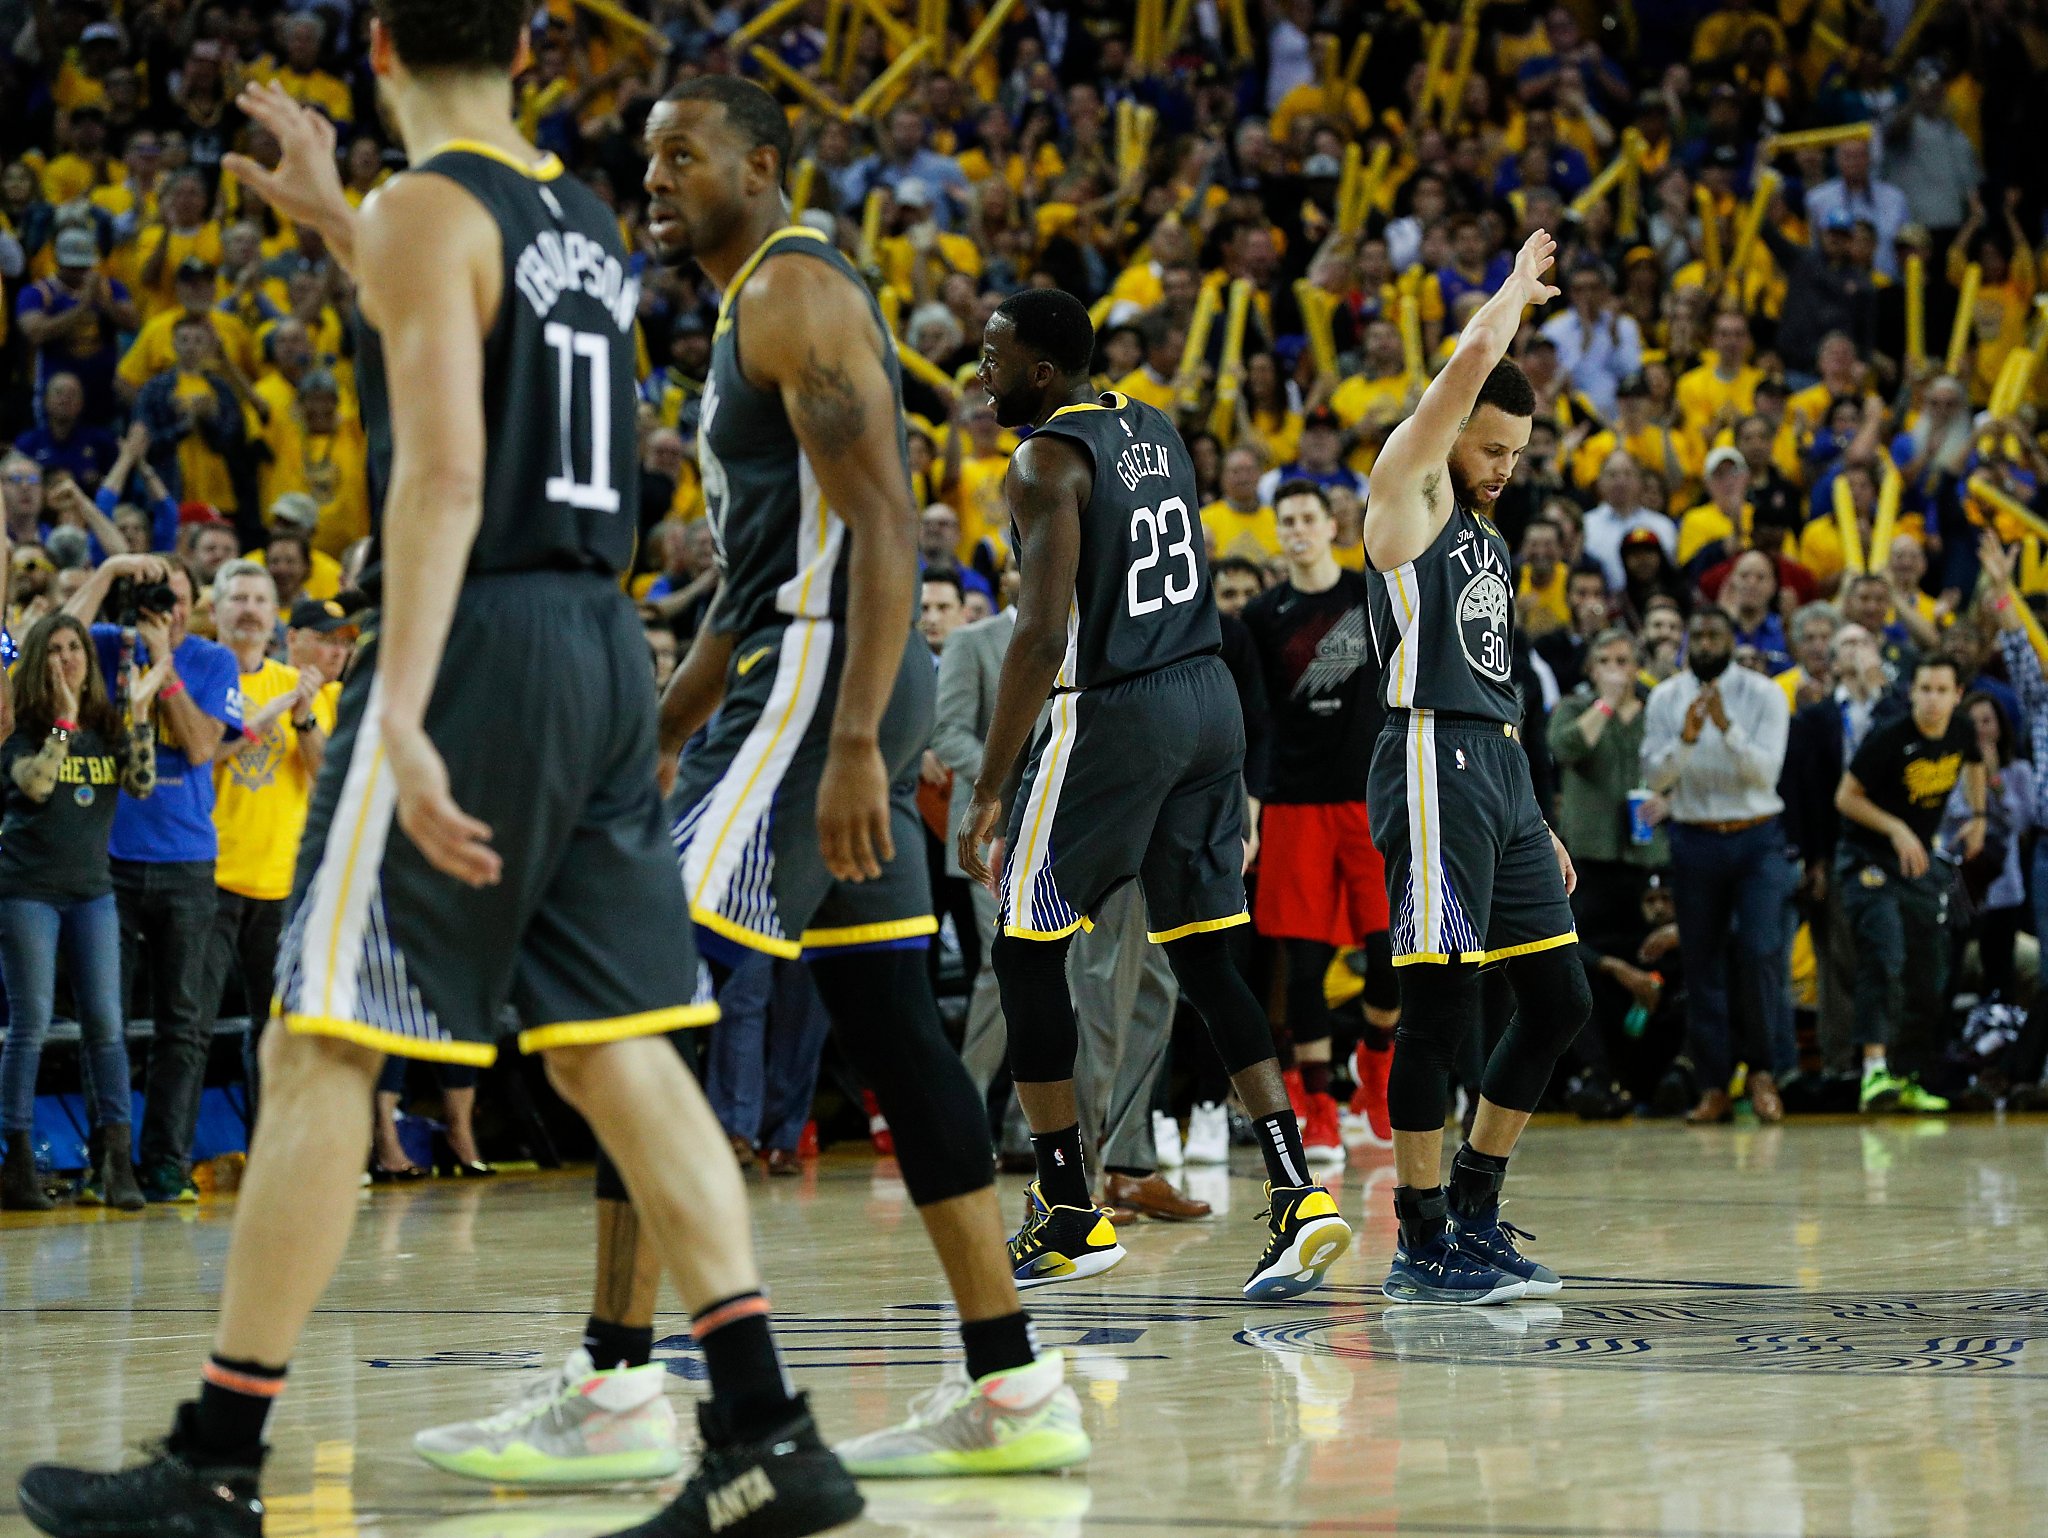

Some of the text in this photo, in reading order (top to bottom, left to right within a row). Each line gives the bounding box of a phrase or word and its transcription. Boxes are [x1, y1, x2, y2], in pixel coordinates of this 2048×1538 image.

[515, 230, 640, 333] THOPSON
[544, 321, 620, 514] 11
[1116, 442, 1170, 492] GREEN
[1127, 496, 1199, 618] 23
[1457, 528, 1475, 544] The
[1448, 538, 1514, 599] TOW
[1481, 630, 1505, 673] 30
[59, 756, 86, 784] HE
[706, 1465, 777, 1534] ANTA
